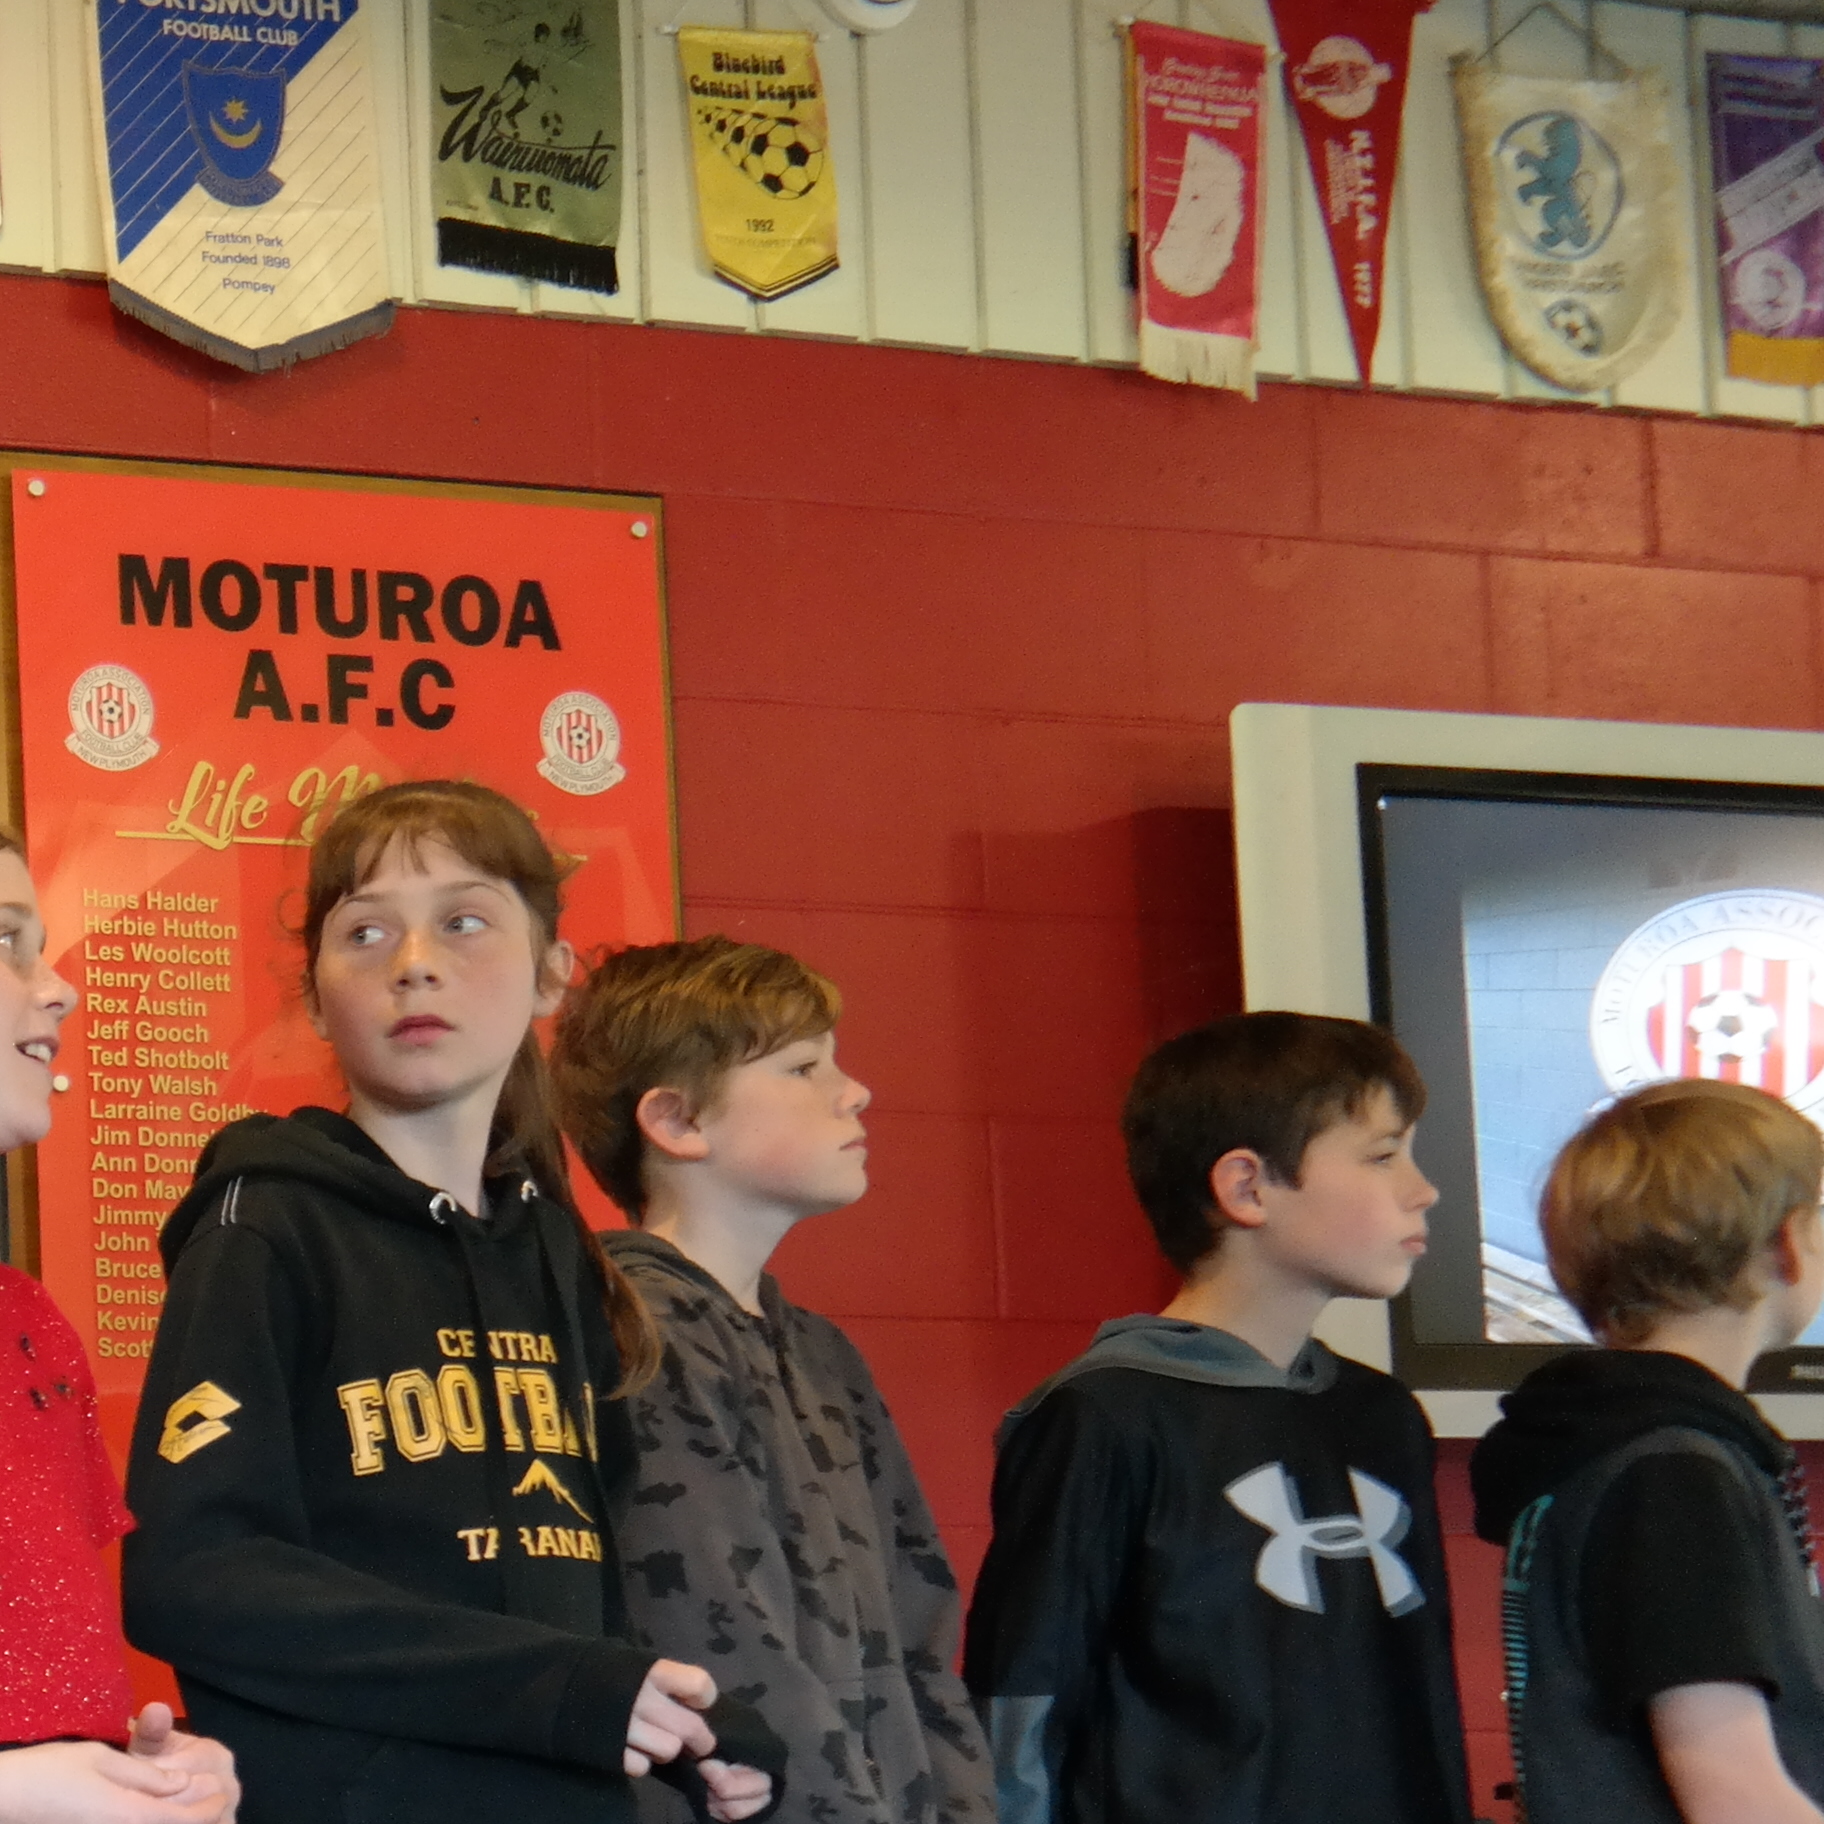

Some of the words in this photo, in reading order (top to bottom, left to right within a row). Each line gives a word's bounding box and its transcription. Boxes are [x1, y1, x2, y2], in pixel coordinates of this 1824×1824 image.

[118, 0, 341, 22] RTSMOUTH
[163, 19, 252, 42] FOOTBALL
[256, 27, 300, 46] CLUB
[756, 80, 818, 110] League
[205, 231, 252, 245] Fratton
[255, 234, 284, 247] Park
[201, 251, 258, 265] Founded
[262, 255, 291, 269] 1898
[222, 278, 276, 295] Pompey
[117, 553, 563, 652] MOTUROA
[233, 648, 456, 731] A.F.C
[167, 760, 269, 848] Life
[83, 888, 140, 909] Hans
[146, 890, 219, 913] Halder
[84, 914, 156, 936] Herbie
[163, 917, 237, 940] Hutton
[85, 940, 125, 961] Les
[131, 942, 231, 966] Woolcott
[85, 966, 151, 994] Henry
[158, 969, 231, 992] Collett
[86, 993, 129, 1014] Rex
[135, 995, 207, 1017] Austin
[87, 1019, 130, 1040] Jeff
[135, 1021, 209, 1043] Gooch
[87, 1045, 128, 1066] Ted
[134, 1047, 229, 1070] Shotbolt
[88, 1072, 142, 1098] Tony
[149, 1074, 218, 1096] Walsh
[90, 1098, 182, 1121] Larraine
[189, 1102, 268, 1122] Goldb
[90, 1125, 131, 1145] Jim
[137, 1126, 216, 1148] Donne
[91, 1151, 137, 1172] Ann
[92, 1178, 137, 1198] Don
[93, 1204, 167, 1231] Jimmy
[94, 1231, 150, 1251] John
[95, 1257, 162, 1278] Bruce
